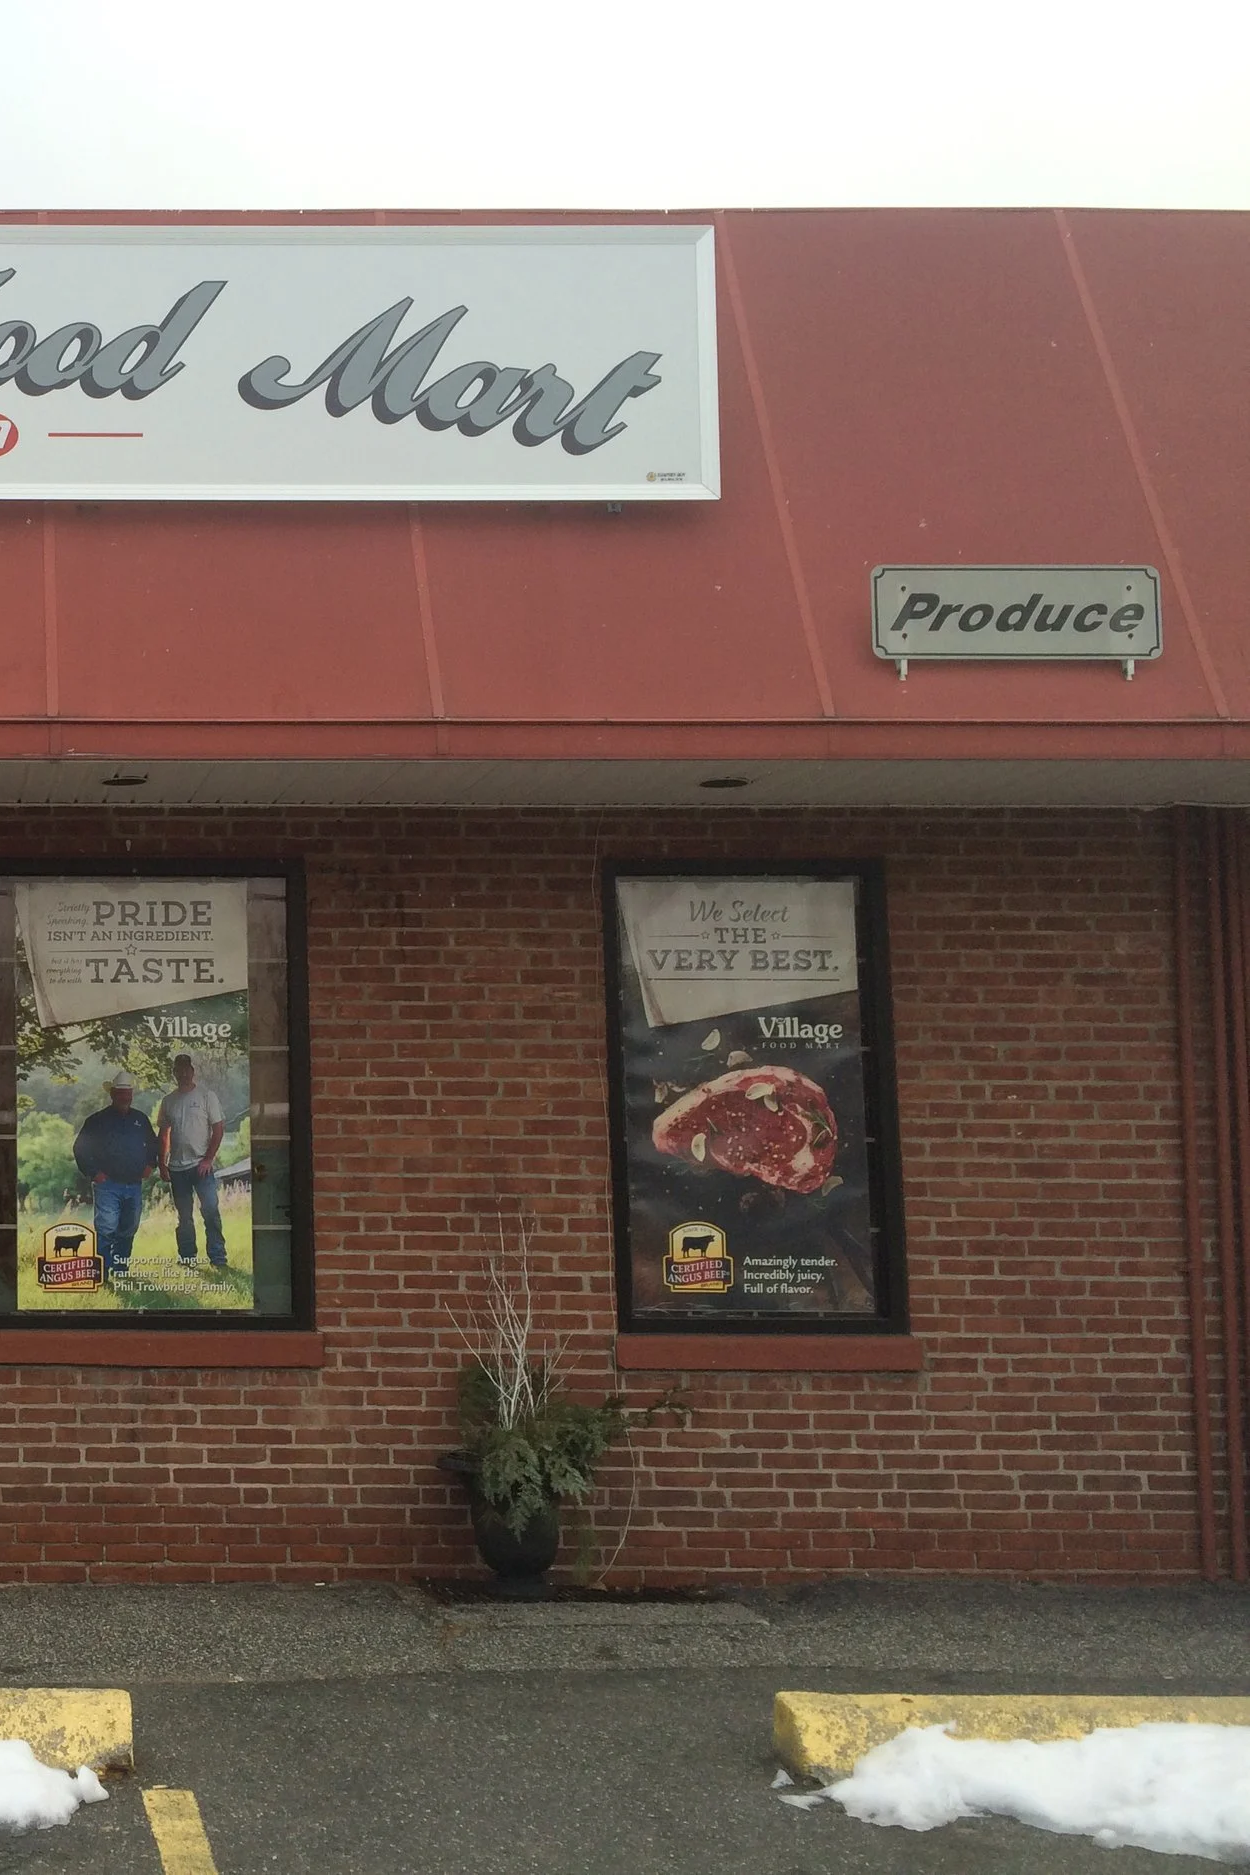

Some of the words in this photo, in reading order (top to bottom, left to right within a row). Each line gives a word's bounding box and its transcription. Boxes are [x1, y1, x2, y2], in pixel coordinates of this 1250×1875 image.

[238, 296, 663, 455] Mart
[890, 593, 1145, 633] Produce
[93, 901, 212, 926] PRIDE
[690, 900, 723, 922] We
[729, 900, 790, 923] Select
[47, 930, 86, 941] ISN'T
[90, 930, 112, 941] AN
[117, 930, 214, 941] INGREDIENT.
[714, 928, 767, 944] THE
[646, 950, 739, 971] VERY
[749, 950, 839, 972] BEST.
[85, 958, 224, 984] TASTE.
[146, 1016, 231, 1042] Village
[758, 1017, 843, 1044] Village
[43, 1259, 94, 1273] CERTIFIED
[113, 1254, 172, 1268] Supporting
[176, 1255, 209, 1268] Angus
[671, 1260, 723, 1274] CERTIFIED
[743, 1255, 797, 1269] Amazingly
[800, 1255, 838, 1266] tender.
[40, 1271, 73, 1282] ANGUS
[113, 1269, 159, 1278] ranchers
[162, 1268, 180, 1278] like
[183, 1268, 199, 1278] the
[668, 1272, 702, 1283] ANGUS
[743, 1269, 795, 1283] Incredibly
[796, 1269, 825, 1283] juicy.
[113, 1281, 133, 1291] Phil
[135, 1281, 197, 1294] Trowbridge
[744, 1283, 763, 1293] Full
[766, 1283, 779, 1293] of
[780, 1283, 814, 1293] flavor.
